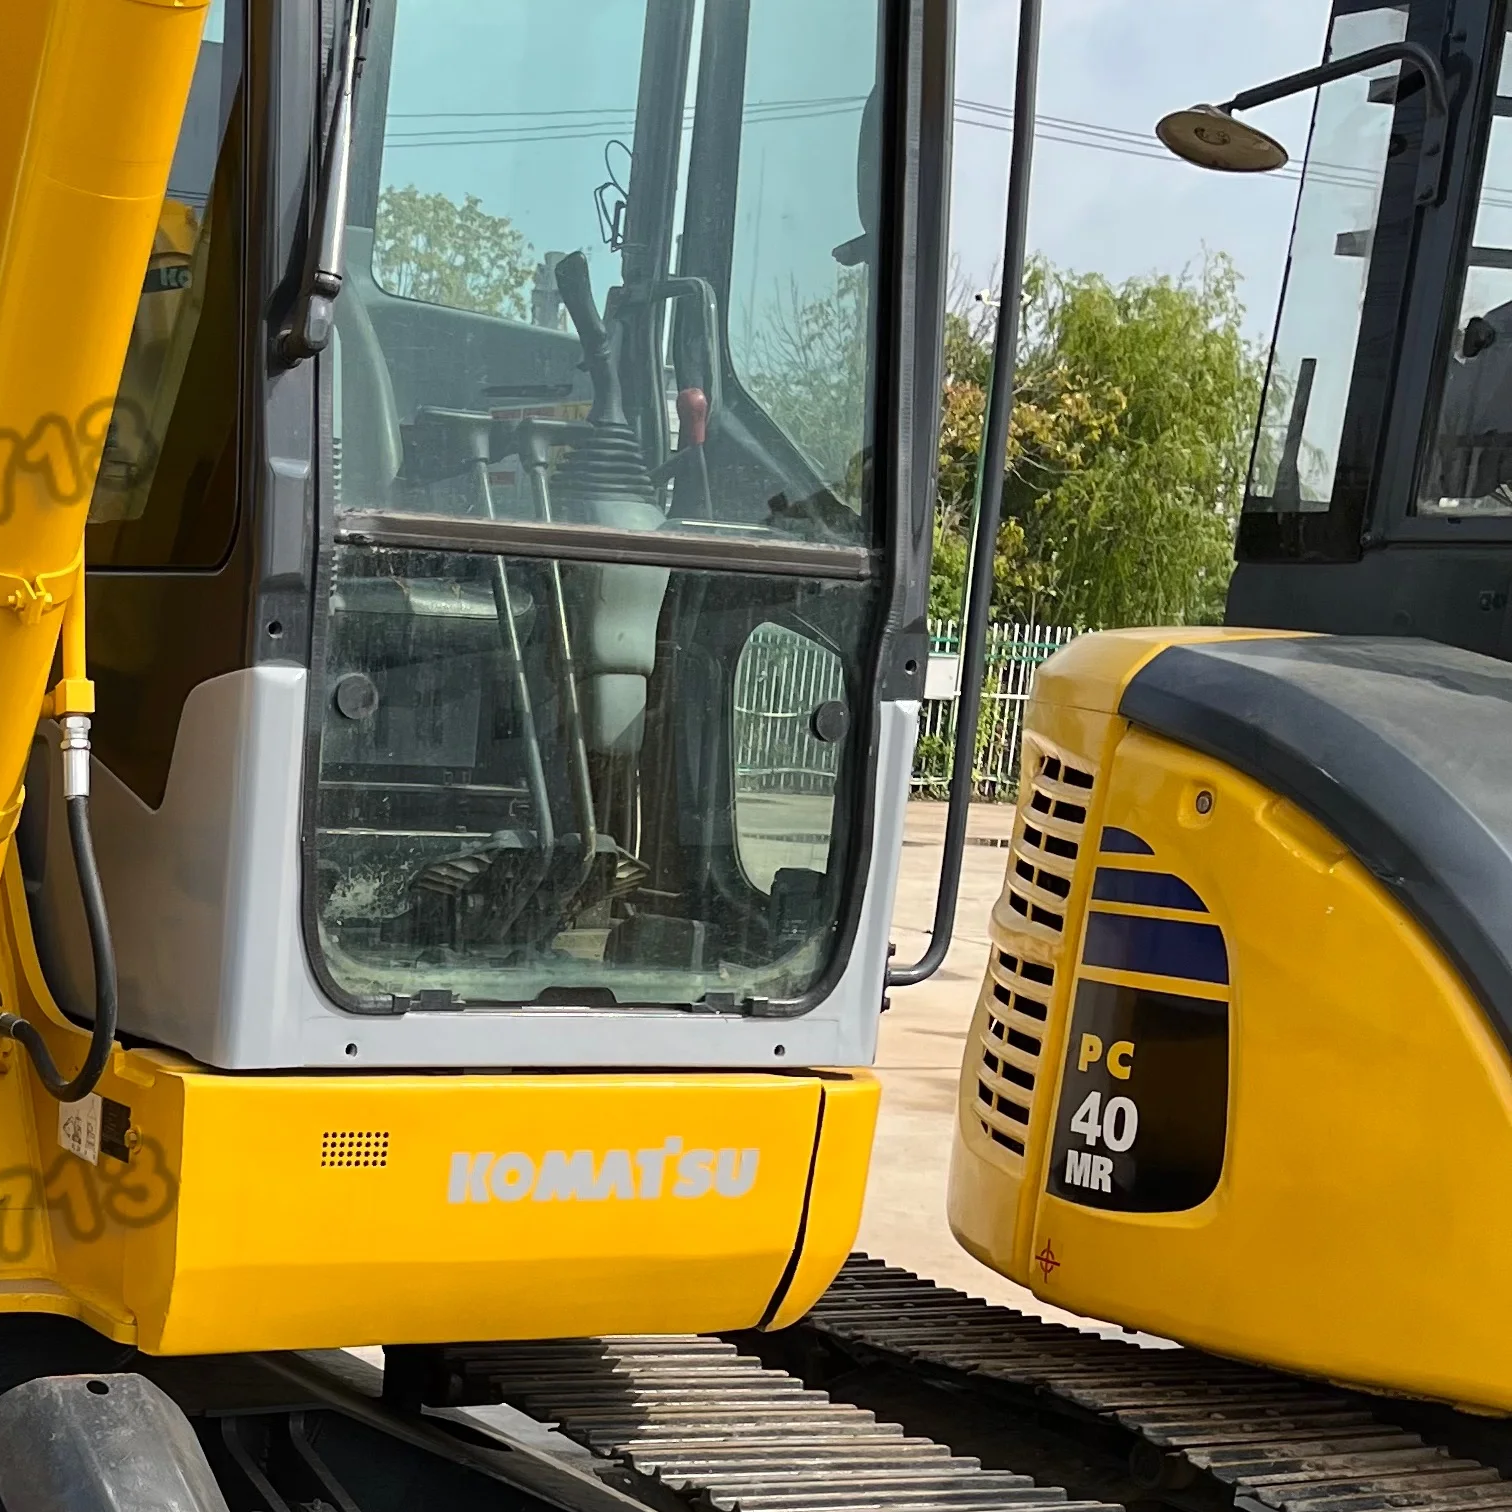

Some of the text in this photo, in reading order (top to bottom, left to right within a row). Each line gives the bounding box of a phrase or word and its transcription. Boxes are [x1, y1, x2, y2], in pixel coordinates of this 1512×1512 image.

[1077, 1033, 1135, 1081] PC
[1070, 1089, 1140, 1153] 40
[447, 1136, 760, 1205] KOMATSU
[1064, 1149, 1115, 1194] MR
